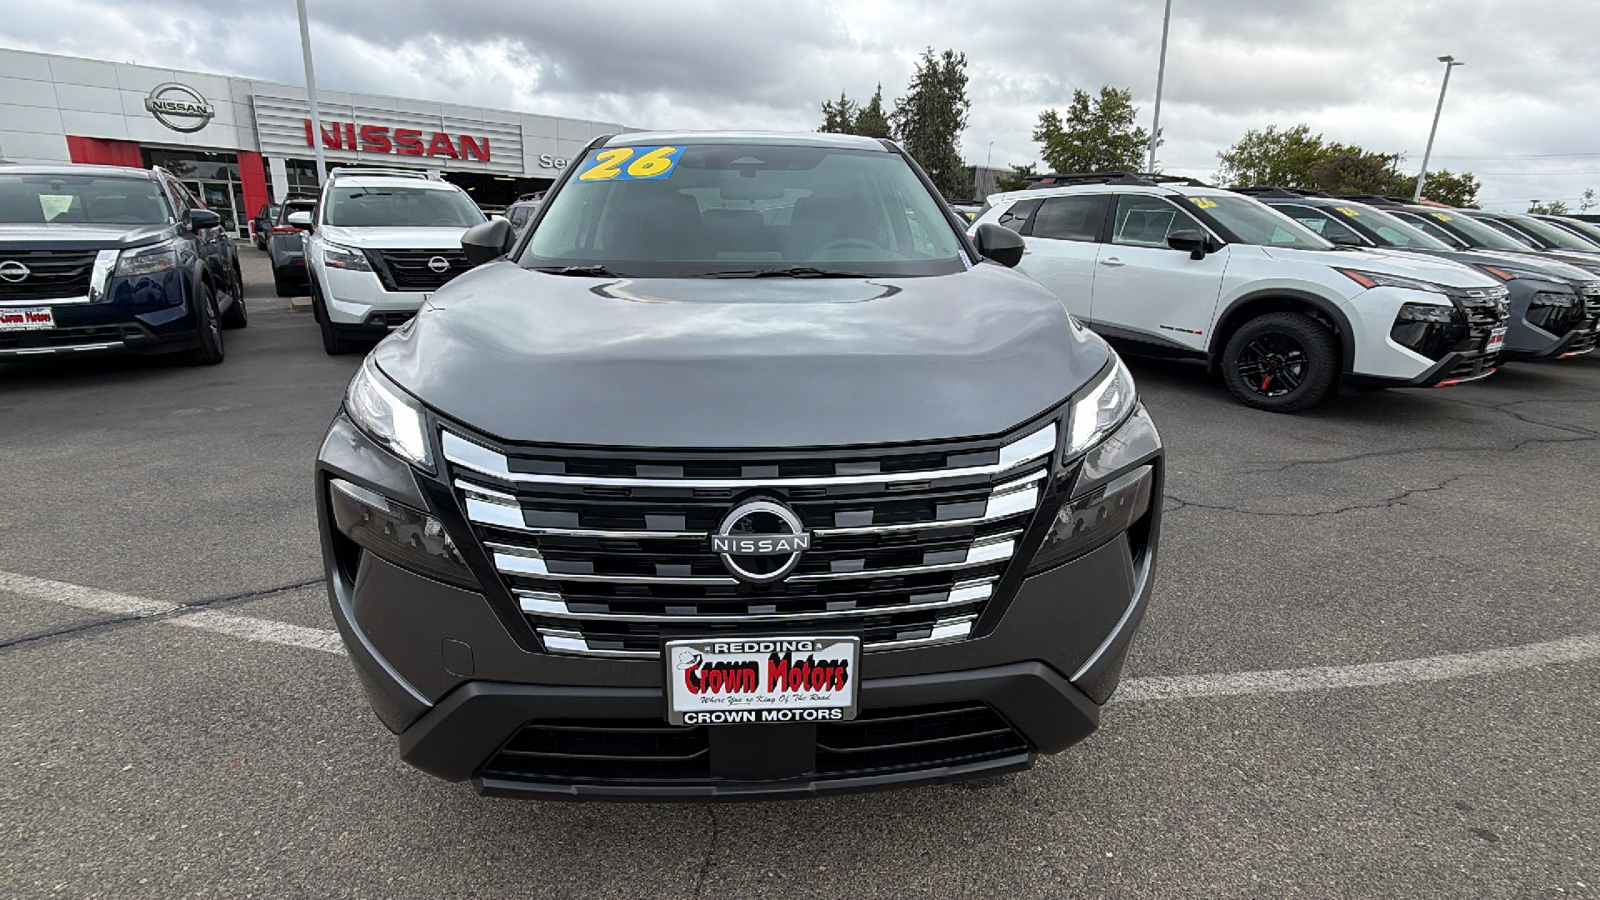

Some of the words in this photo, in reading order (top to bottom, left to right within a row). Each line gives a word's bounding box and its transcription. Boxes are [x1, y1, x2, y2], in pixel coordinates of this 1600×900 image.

[152, 100, 208, 115] NISSAN
[304, 118, 491, 162] NISSAN
[578, 146, 678, 181] 26
[1189, 196, 1217, 209] 26
[714, 536, 809, 553] NISSAN
[714, 641, 814, 653] REDDING
[684, 655, 759, 695] Crown
[767, 652, 850, 694] Motors
[700, 695, 725, 705] Where
[756, 695, 776, 704] King
[778, 693, 790, 703] Of
[792, 693, 807, 702] The
[809, 693, 831, 702] Road
[683, 711, 756, 724] CROWN
[761, 708, 843, 722] MOTORS
